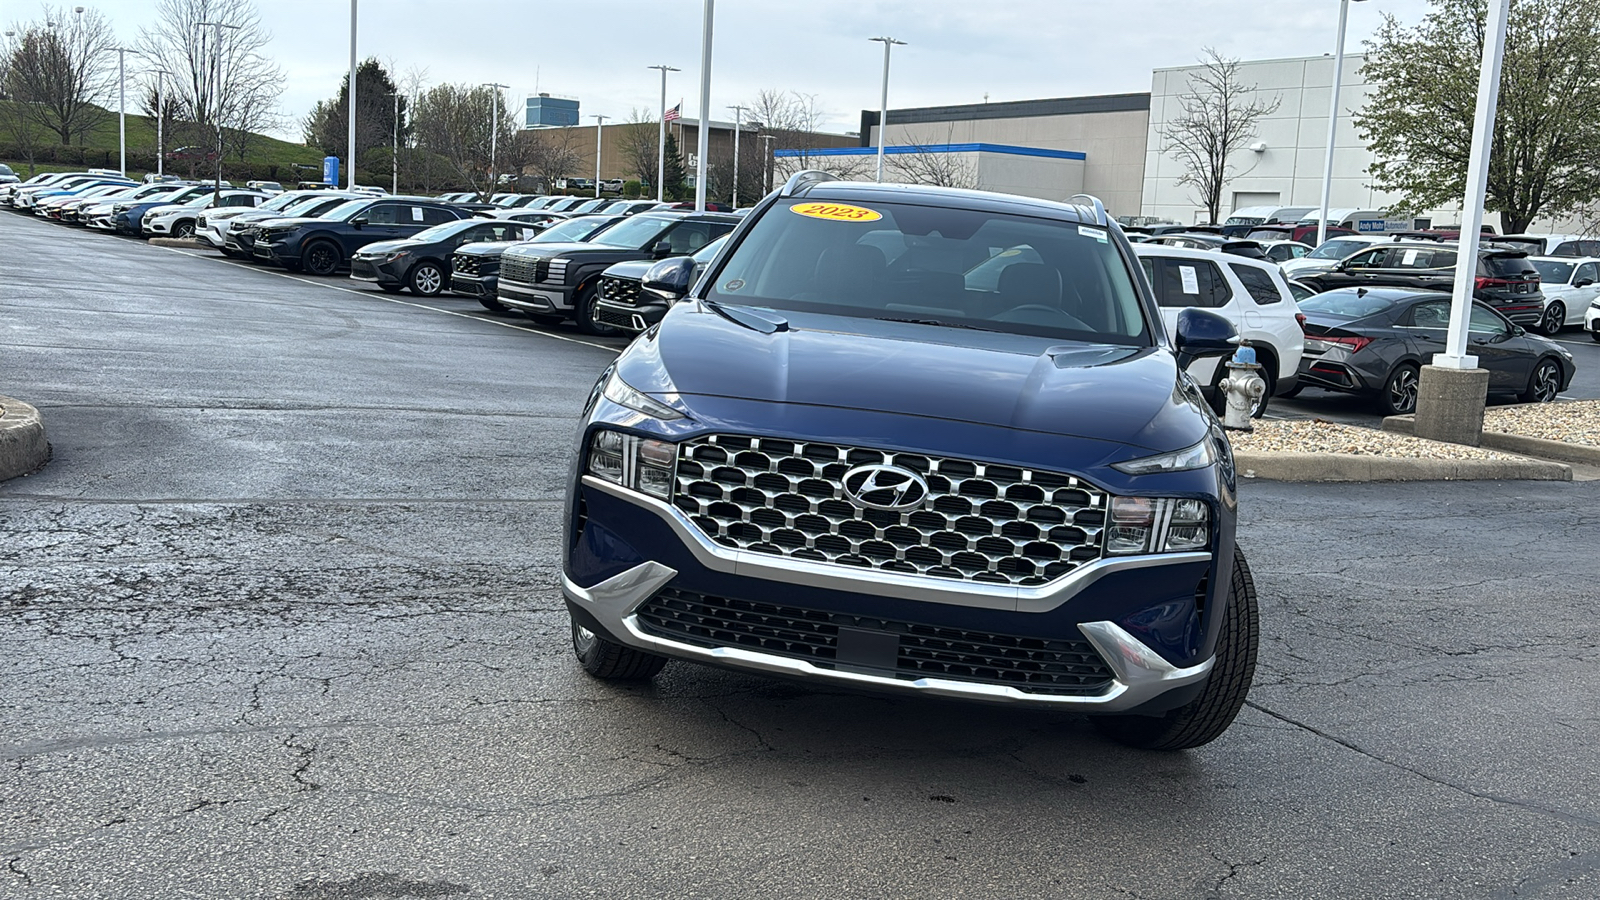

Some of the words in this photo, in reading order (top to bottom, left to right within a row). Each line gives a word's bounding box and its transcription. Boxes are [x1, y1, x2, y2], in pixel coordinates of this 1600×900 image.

[803, 205, 869, 219] 2023
[1359, 221, 1371, 231] Andy
[1372, 221, 1384, 230] Mohr
[1385, 221, 1408, 230] Automotive
